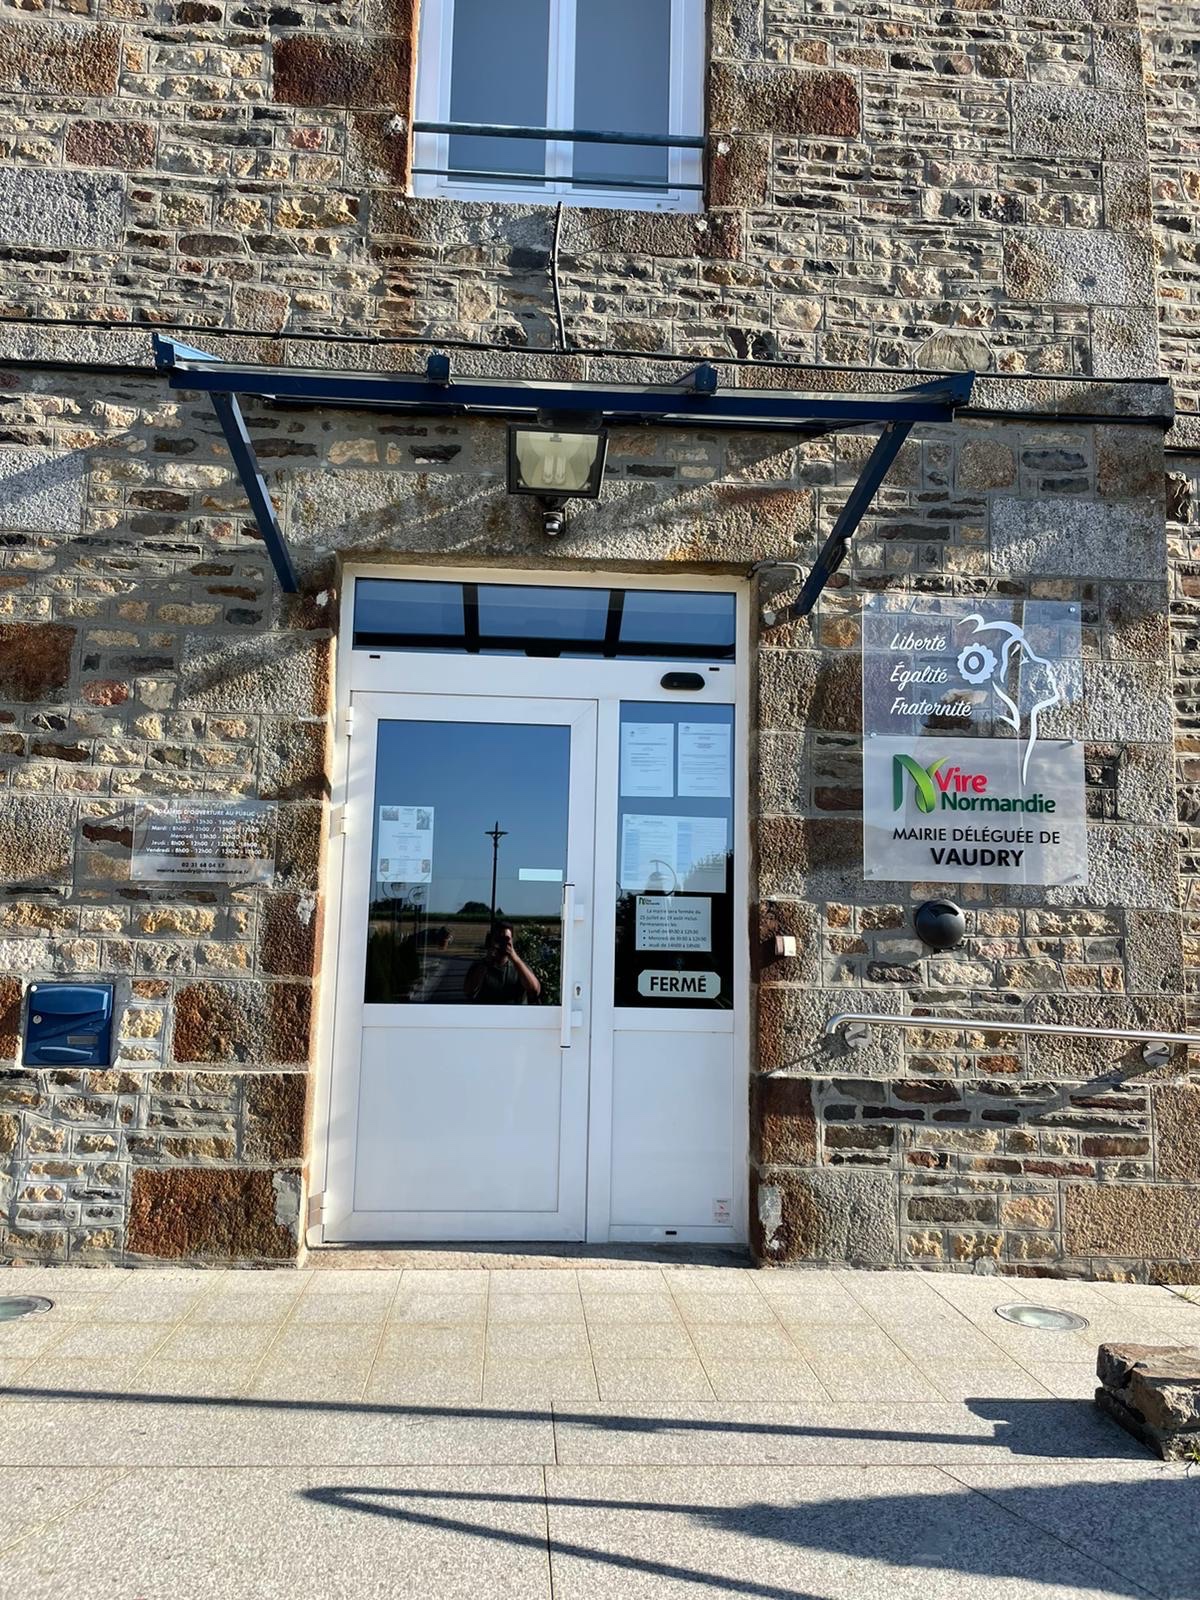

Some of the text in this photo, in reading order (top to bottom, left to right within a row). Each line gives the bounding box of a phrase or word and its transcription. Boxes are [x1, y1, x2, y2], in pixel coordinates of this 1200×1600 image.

[890, 632, 948, 651] Liberté
[890, 662, 948, 692] Égalité
[890, 697, 973, 718] Fraternité
[934, 767, 988, 793] Vire
[941, 792, 1056, 813] Normandie
[893, 826, 1061, 844] MAIRIE DÉLÉGUÉE DE
[930, 847, 1024, 867] VAUDRY
[650, 975, 707, 993] FERMÉ
